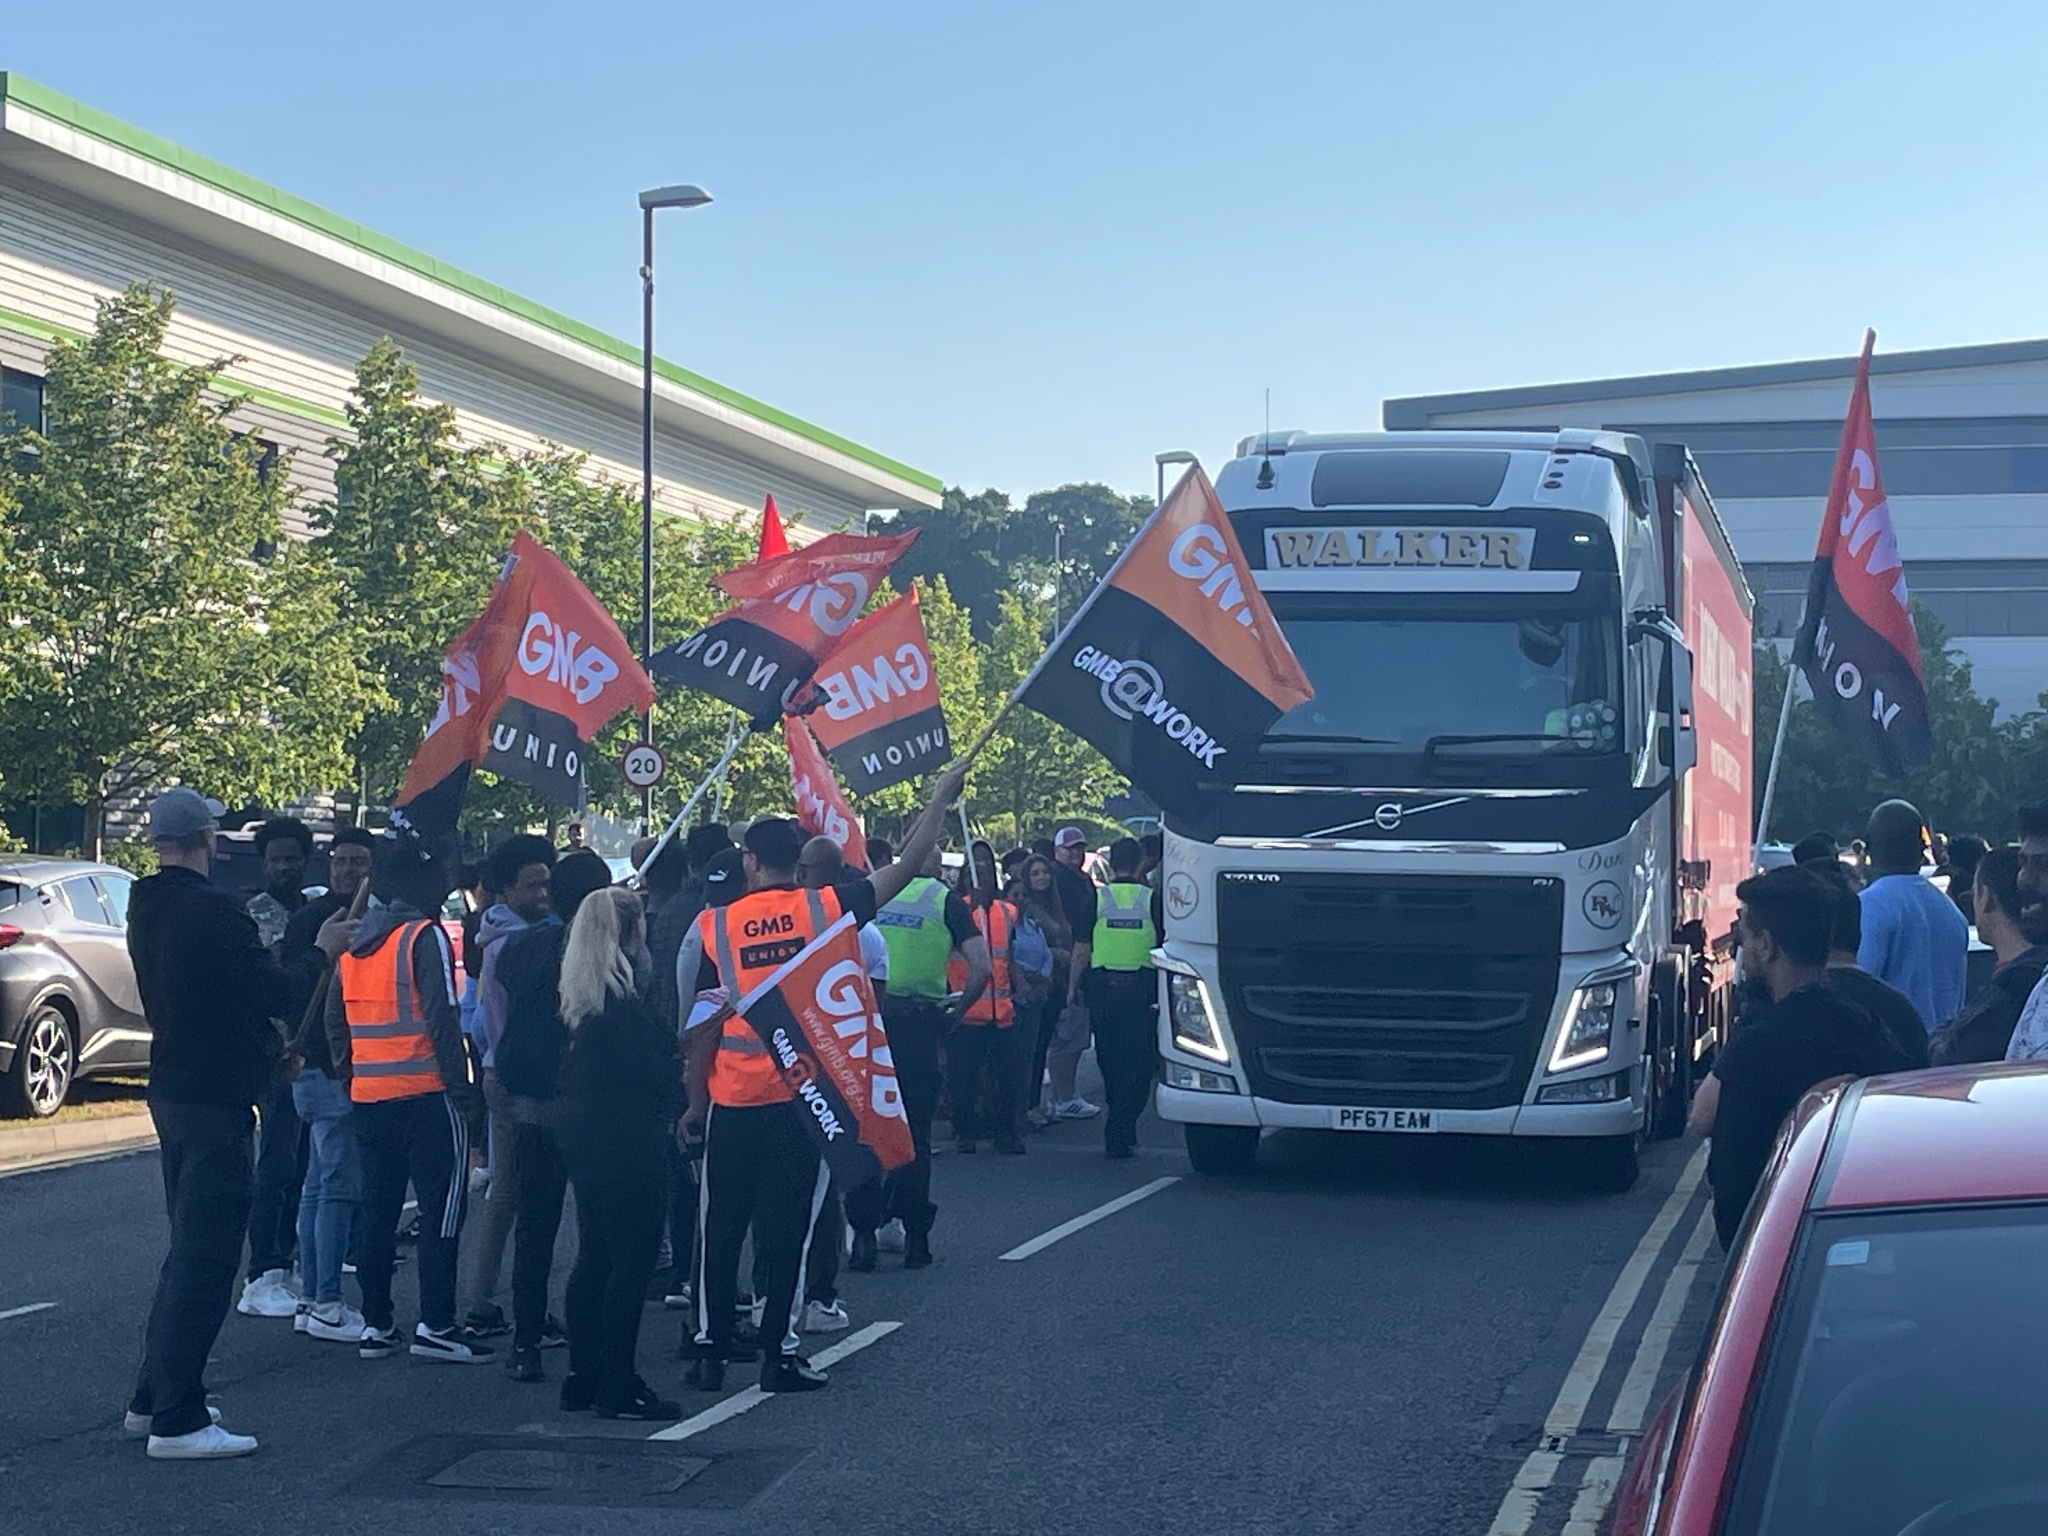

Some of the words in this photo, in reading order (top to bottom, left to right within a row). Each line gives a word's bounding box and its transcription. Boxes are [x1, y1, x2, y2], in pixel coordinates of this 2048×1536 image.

[1272, 530, 1525, 570] WALKER
[1168, 523, 1261, 640] GM
[518, 611, 620, 705] GMB
[493, 724, 579, 778] UNIO
[630, 757, 657, 775] 20
[743, 914, 795, 938] GMB
[1340, 1109, 1390, 1128] PF67
[1394, 1111, 1431, 1129] EAW
